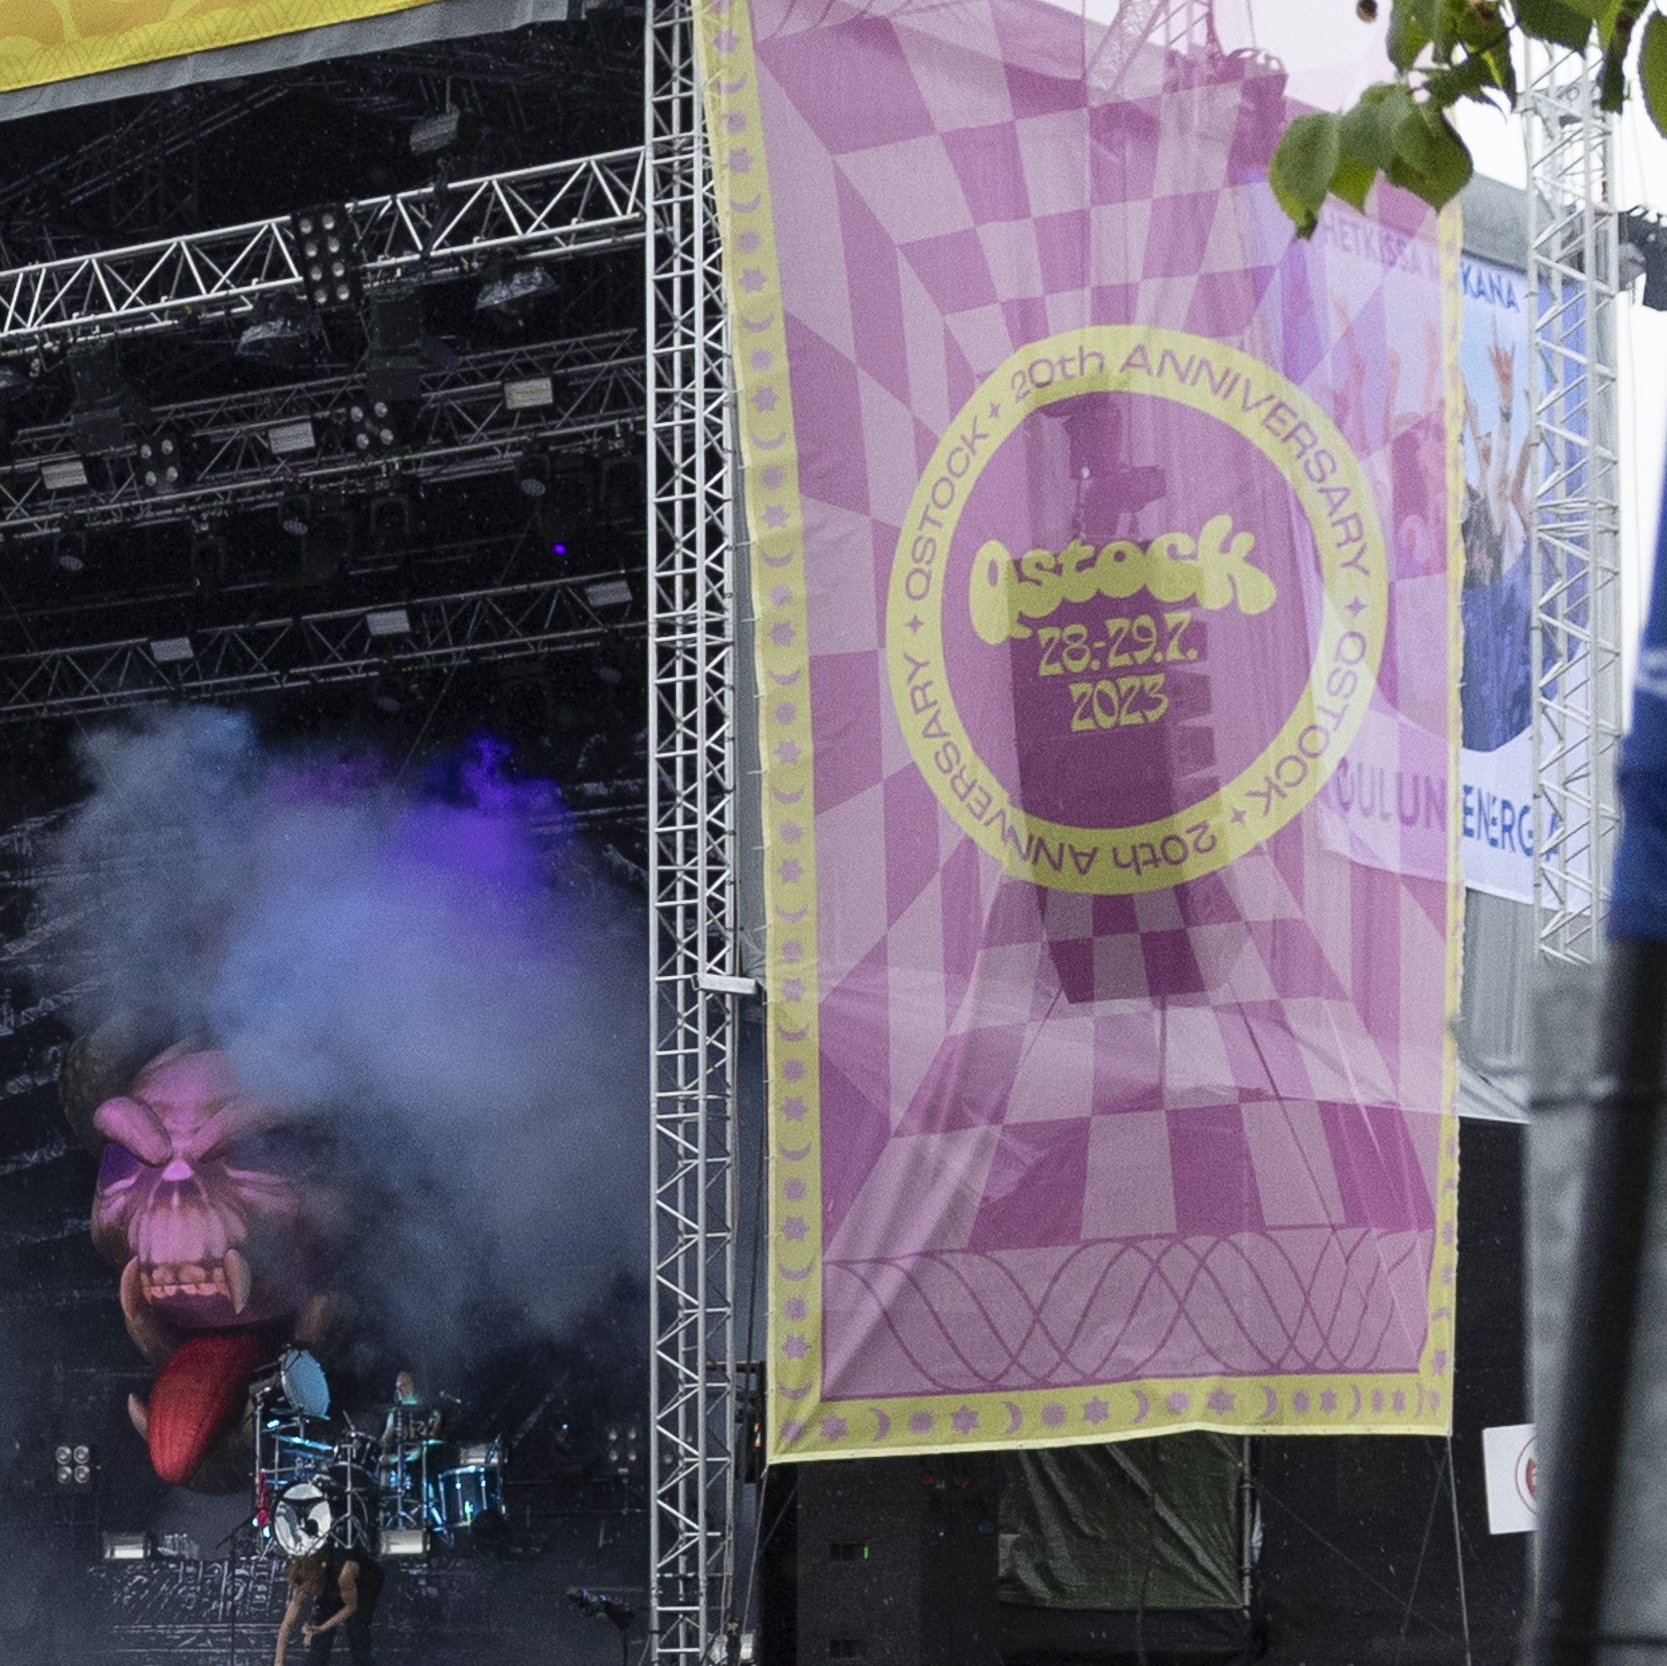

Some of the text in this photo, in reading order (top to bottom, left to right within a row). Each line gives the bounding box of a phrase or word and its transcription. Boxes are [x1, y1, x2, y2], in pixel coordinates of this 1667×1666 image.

[905, 344, 1373, 602] QSTOCK 20th ANNIVERSARY
[1069, 673, 1170, 733] 2023
[1246, 630, 1368, 817] QSTOCK
[1112, 820, 1218, 877] 20th
[1463, 784, 1560, 862] ENERGA
